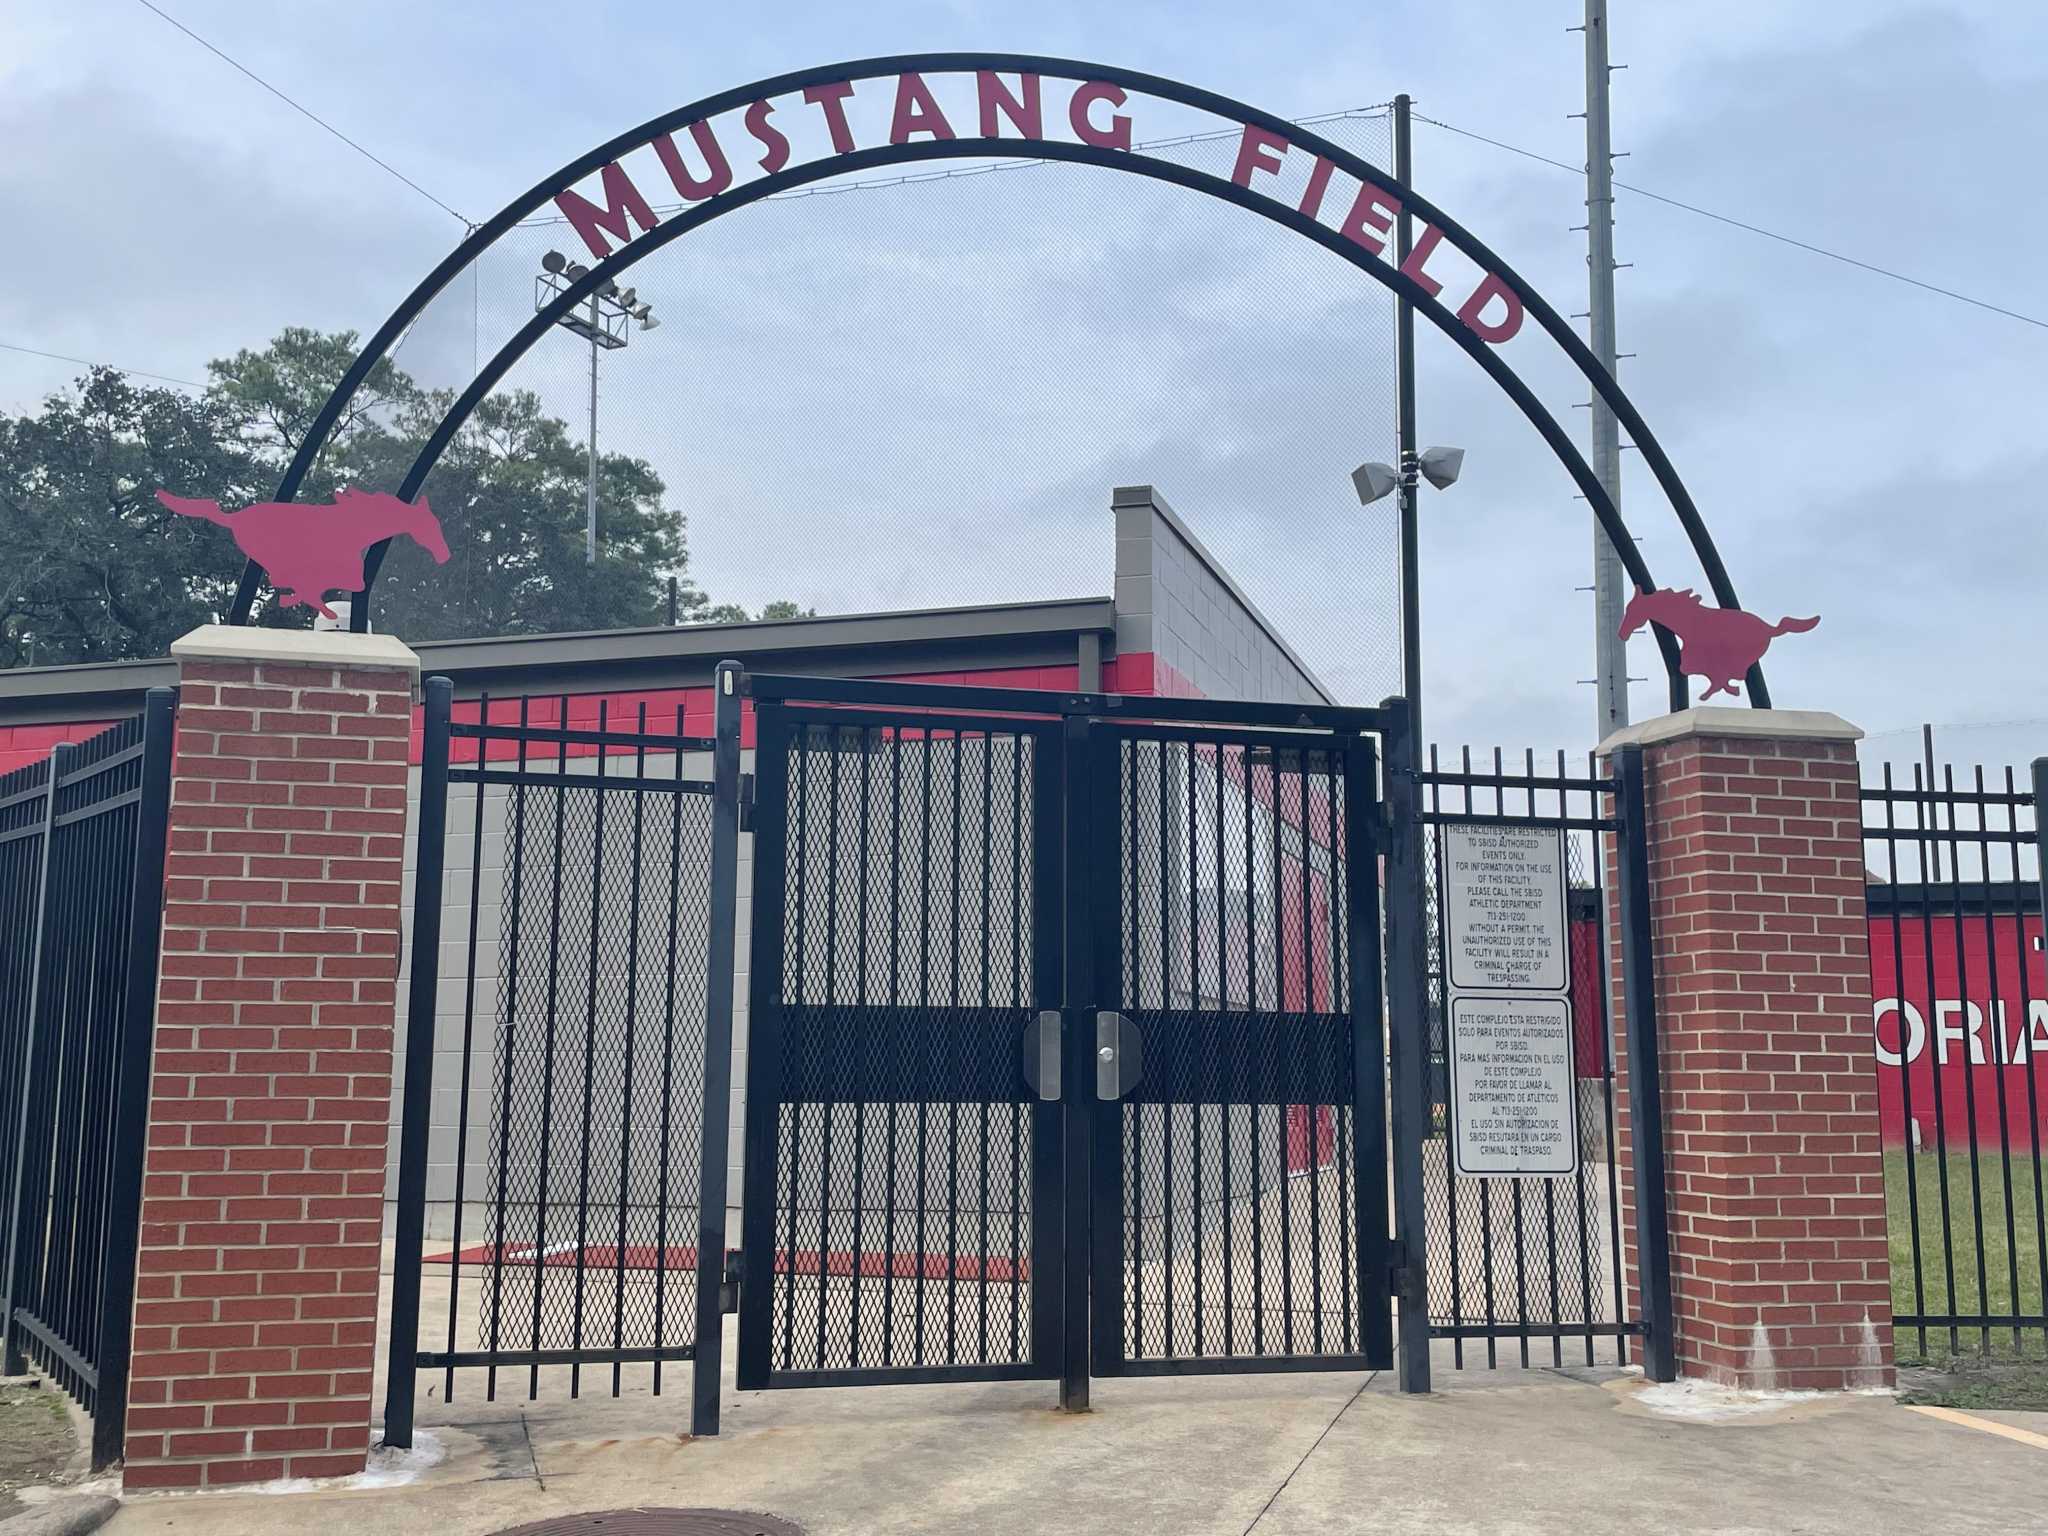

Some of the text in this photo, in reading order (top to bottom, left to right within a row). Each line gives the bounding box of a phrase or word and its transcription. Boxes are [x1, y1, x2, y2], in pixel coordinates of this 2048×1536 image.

[554, 70, 1524, 343] MUSTANG FIELD
[1449, 825, 1468, 834] THESE
[1468, 838, 1539, 848] TO SBISD AUTHORIZED
[1482, 851, 1506, 859] EVENTS
[1456, 862, 1552, 873] FOR INFORMATION ON THE USE
[1478, 875, 1486, 883] OF
[1489, 875, 1502, 884] THIS
[1468, 887, 1542, 897] PLEASE CALL THE SBISD
[1470, 899, 1542, 909] ATHLETIC DEPARTMENT
[1469, 924, 1499, 932] WITHOUT
[1533, 925, 1544, 934] THE
[1463, 936, 1551, 946] UNAUTHORIZED USE OF THIS
[1465, 948, 1492, 957] FACILITY
[1495, 949, 1510, 957] WILL
[1512, 949, 1534, 958] RESULT
[1537, 950, 1543, 958] IN
[1474, 961, 1542, 970] CRIMINAL CHARGE OF
[1460, 1014, 1475, 1024] ESTE
[1477, 1015, 1508, 1024] COMPLEJO
[1510, 1015, 1524, 1024] ESTA
[1459, 1027, 1563, 1038] SOLO PARA EVENTOS AUTORIZADOS
[1496, 1041, 1508, 1050] POR
[1460, 1054, 1564, 1064] PARA MAS INFORMACION EN EL USO
[1484, 1067, 1541, 1076] DE ESTE COMPLEJO
[1475, 1080, 1552, 1089] POR FAVOR DE LLAMAR AL
[1469, 1093, 1559, 1102] DEPARTAMENTO DE ATLETICOS
[1492, 1107, 1499, 1115] AL
[1472, 1120, 1559, 1129] EL USO SIN AUTORIZACION DE
[1470, 1133, 1487, 1141] SBISD
[1521, 1133, 1528, 1142] EN
[1531, 1133, 1539, 1142] UN
[1541, 1133, 1561, 1142] CARGO
[1480, 1146, 1508, 1155] CRIMINAL
[1511, 1146, 1518, 1155] DE
